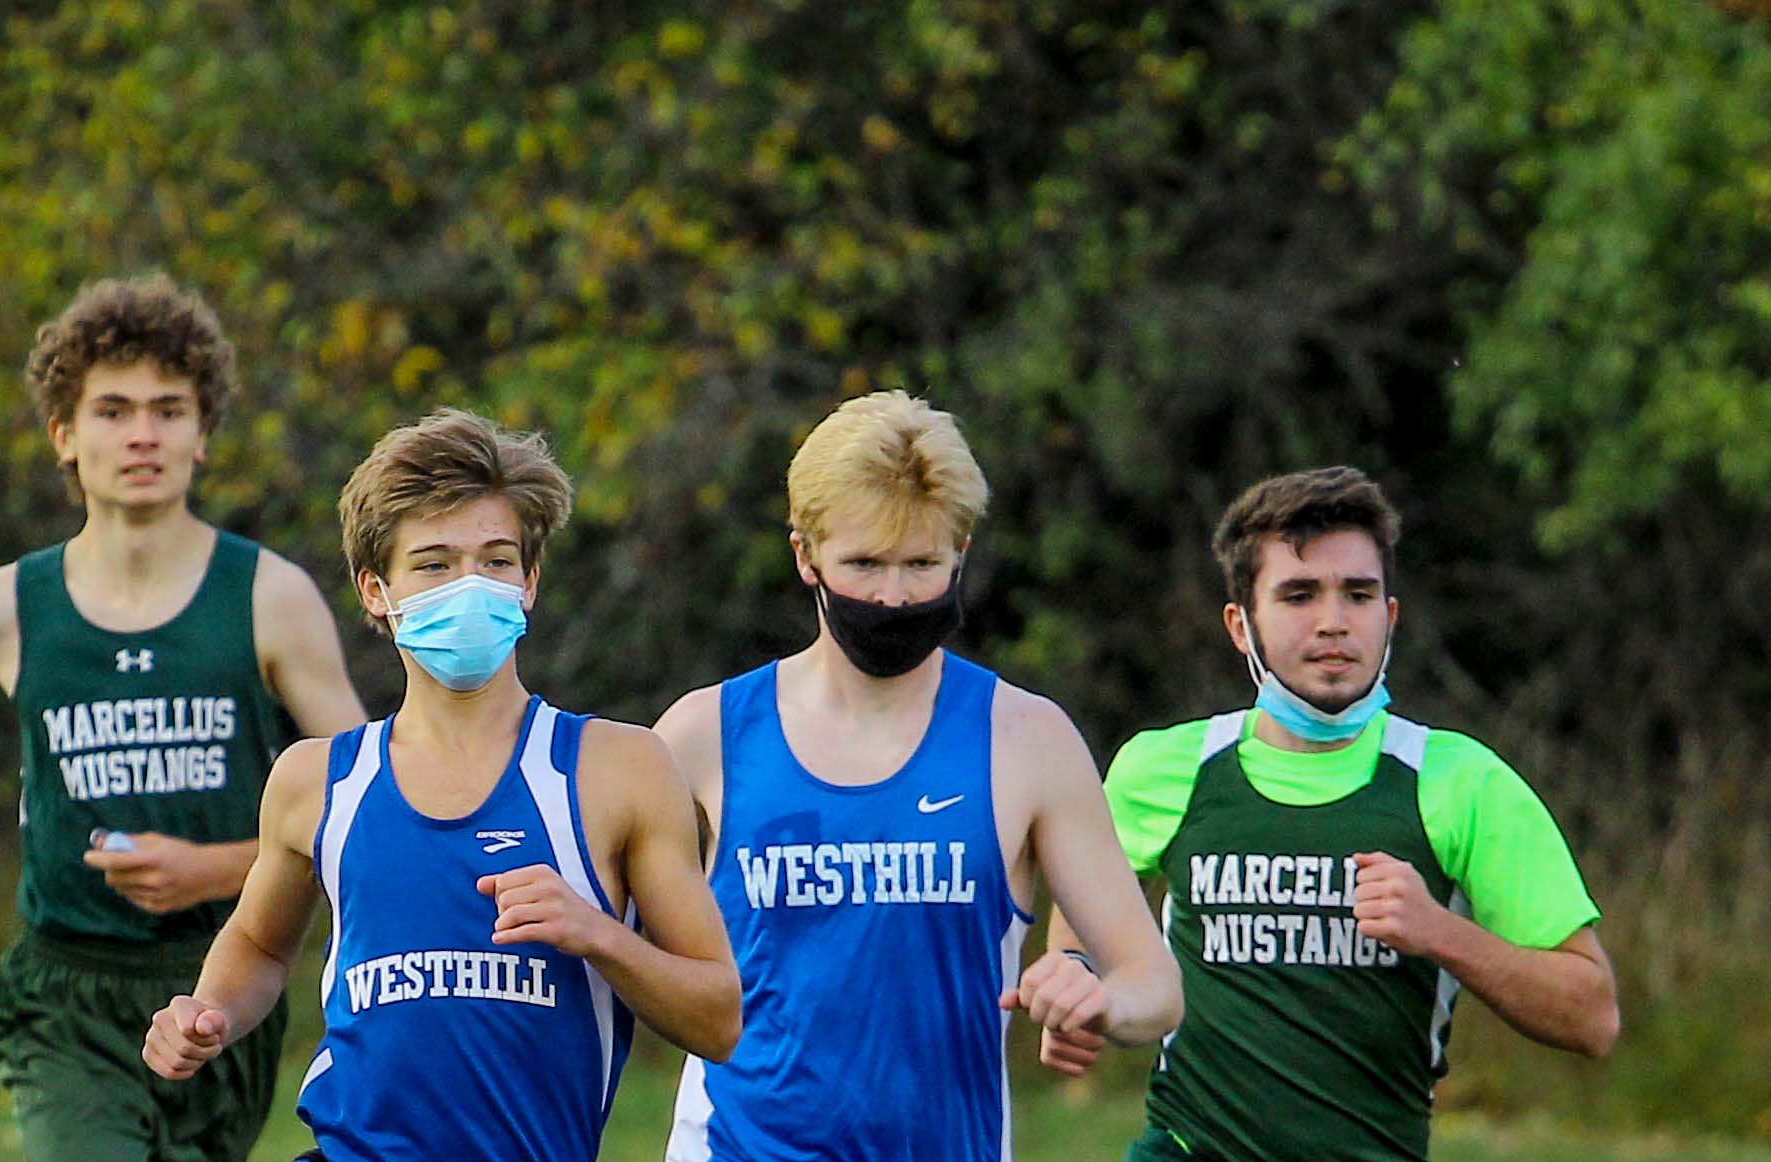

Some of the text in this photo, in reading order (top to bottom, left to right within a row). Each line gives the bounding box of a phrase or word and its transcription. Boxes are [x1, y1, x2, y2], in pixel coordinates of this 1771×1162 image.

[42, 696, 237, 754] MARCELLUS
[59, 745, 228, 800] MUSTANGS
[736, 841, 976, 909] WESTHILL
[1189, 854, 1359, 907] MARCELL
[345, 950, 556, 1014] WESTHILL
